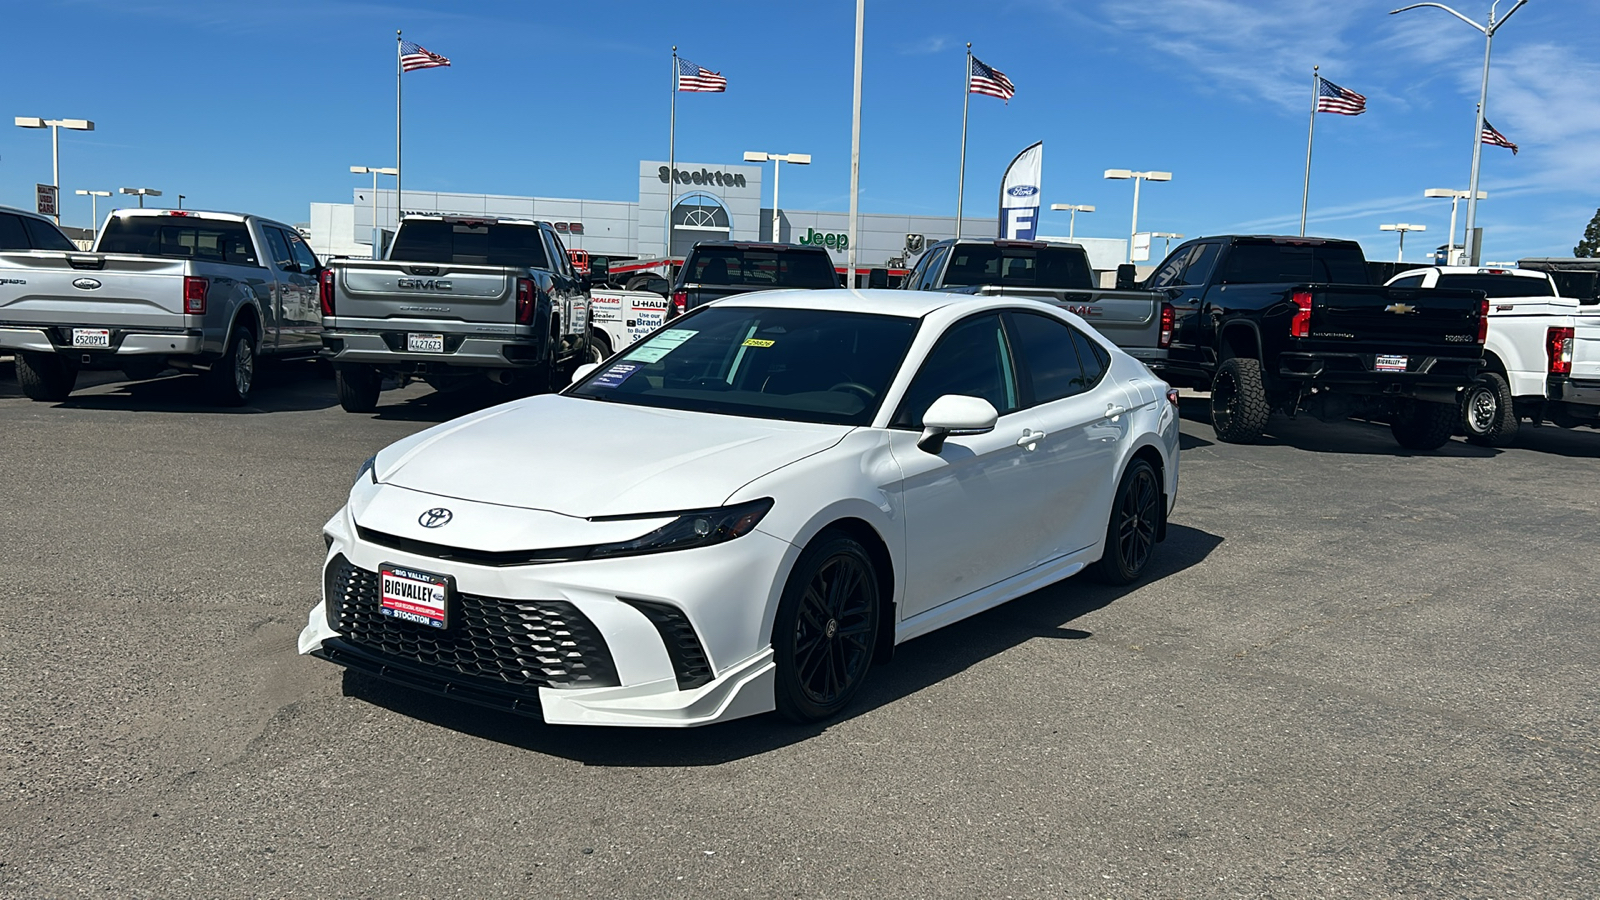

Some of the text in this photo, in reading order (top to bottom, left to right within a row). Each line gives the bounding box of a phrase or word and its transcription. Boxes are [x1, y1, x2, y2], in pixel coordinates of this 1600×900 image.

[658, 165, 746, 188] Stockton
[1012, 186, 1034, 196] Ford
[40, 194, 53, 203] USED
[38, 203, 55, 214] CARS
[799, 228, 850, 253] Jeep
[398, 278, 453, 291] GMC
[1057, 305, 1102, 316] MC
[636, 318, 662, 327] Brand
[75, 335, 107, 345] 65209Y1
[395, 569, 430, 582] BIG VALLEY
[385, 579, 433, 602] BIGVALLEY
[393, 610, 430, 625] STOCKTON
